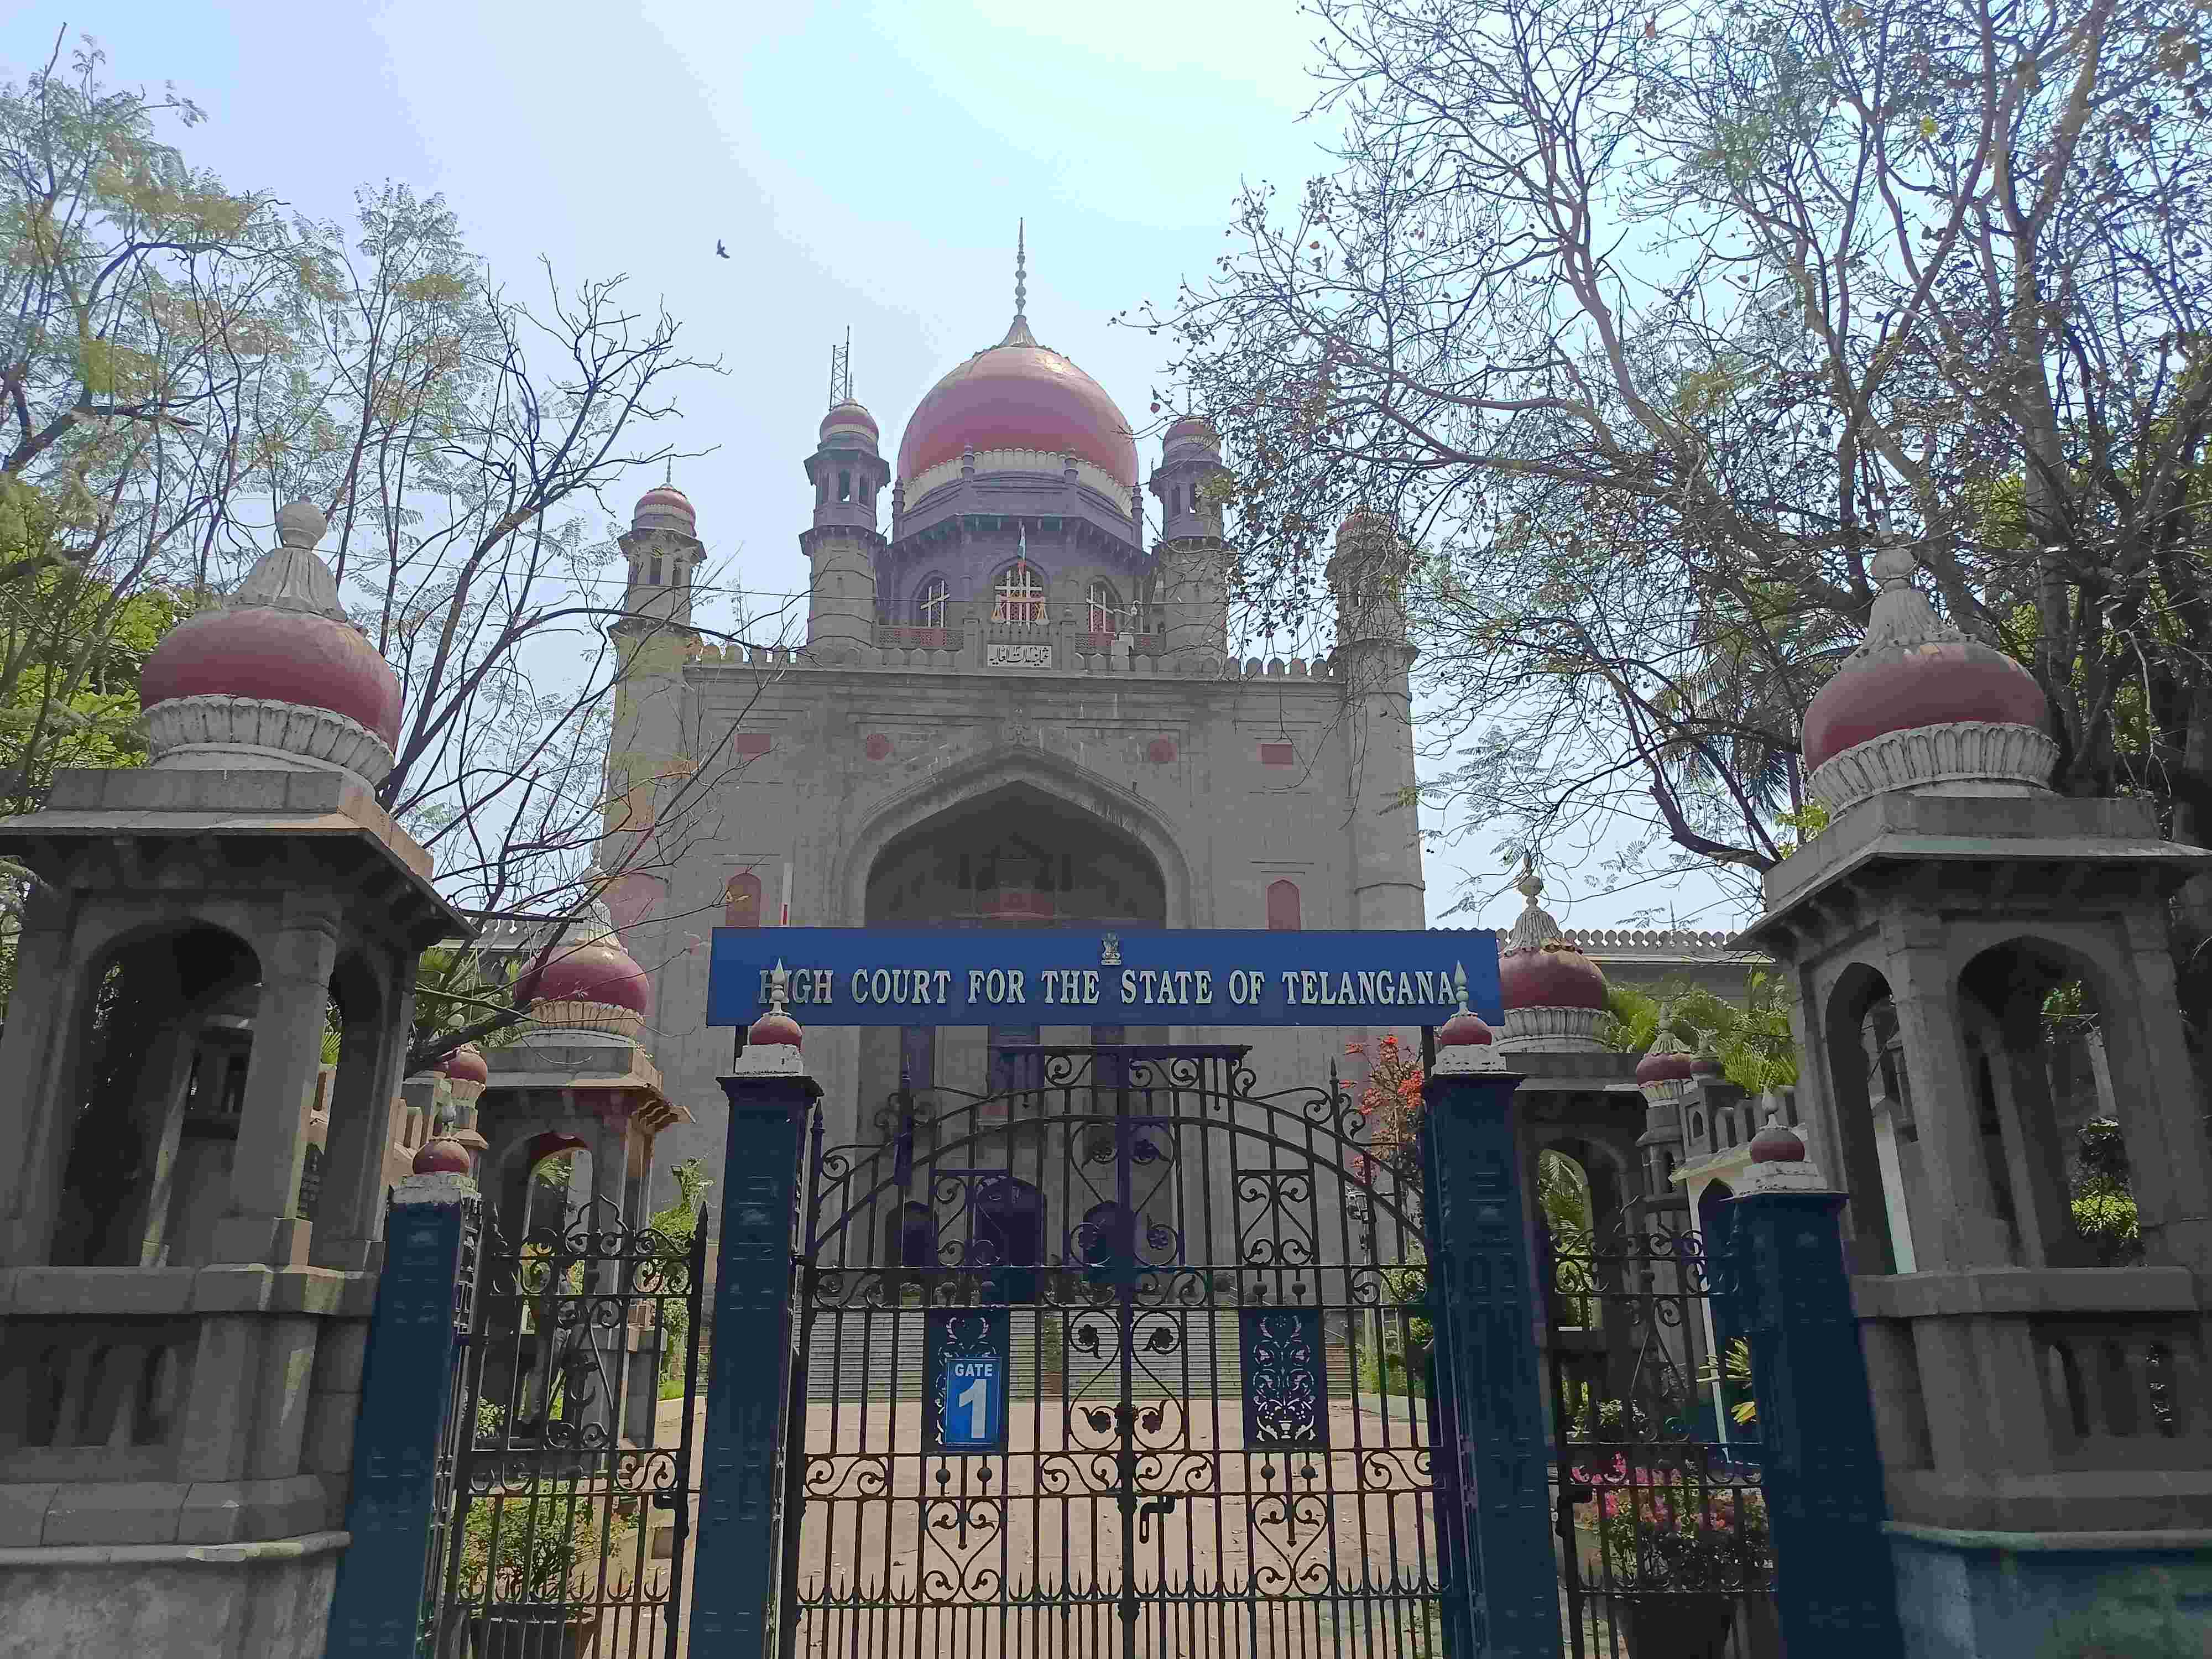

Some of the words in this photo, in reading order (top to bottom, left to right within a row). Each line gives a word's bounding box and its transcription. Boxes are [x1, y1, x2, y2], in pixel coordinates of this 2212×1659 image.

[758, 968, 834, 1004] HIGH
[851, 968, 951, 1005] COURT
[967, 969, 1026, 1004] FOR
[1041, 969, 1099, 1005] THE
[1120, 969, 1213, 1005] STATE
[1228, 969, 1265, 1005] OF
[1281, 969, 1457, 1005] TELANGANA
[954, 1363, 993, 1377] GATE
[959, 1379, 987, 1438] 1
